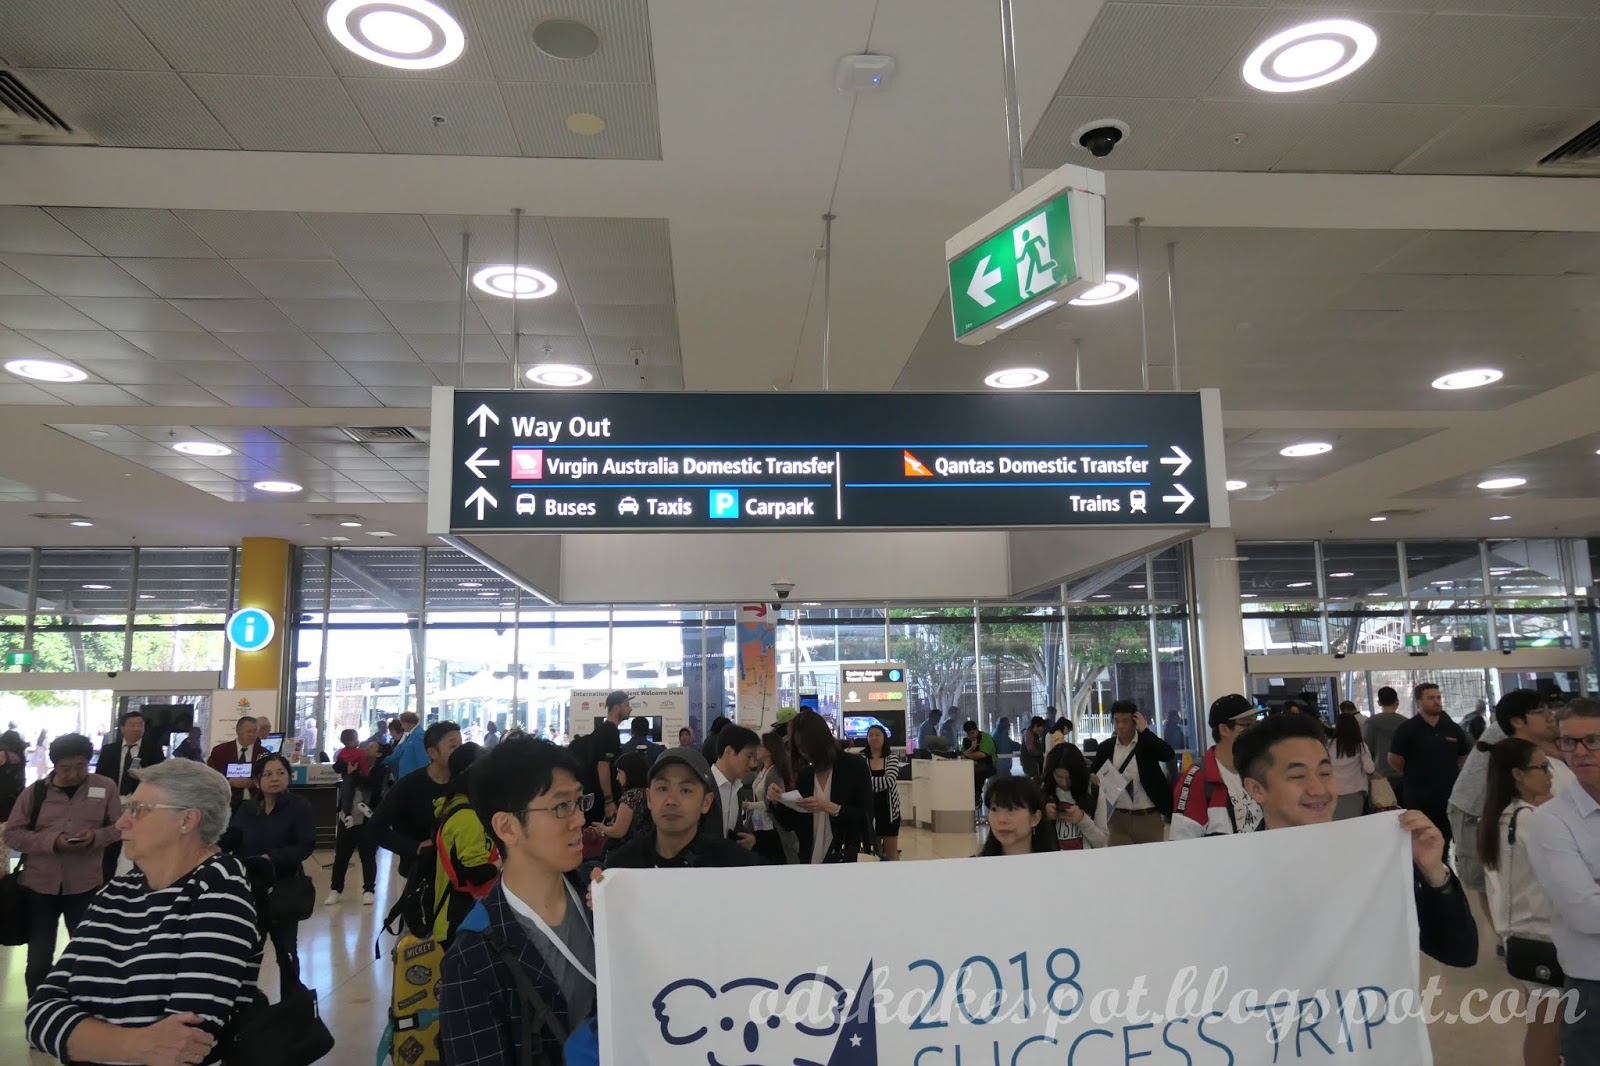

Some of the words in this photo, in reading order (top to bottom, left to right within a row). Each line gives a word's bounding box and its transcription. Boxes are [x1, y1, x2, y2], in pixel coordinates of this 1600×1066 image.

[512, 417, 562, 442] Way
[569, 417, 611, 438] Out
[546, 457, 598, 479] Virgin
[602, 457, 679, 475] Australia
[683, 457, 762, 475] Domestic
[765, 457, 834, 475] Transfer
[935, 457, 994, 477] Qantas
[999, 456, 1077, 474] Domestic
[1079, 456, 1149, 474] Transfer
[545, 499, 597, 516] Buses
[647, 498, 692, 516] Taxis
[716, 493, 734, 514] P
[745, 497, 814, 520] Carpark
[1070, 495, 1120, 512] Trains
[406, 942, 432, 958] MICKEY
[908, 947, 1084, 1031] 2018
[1246, 986, 1390, 1065] TRIP
